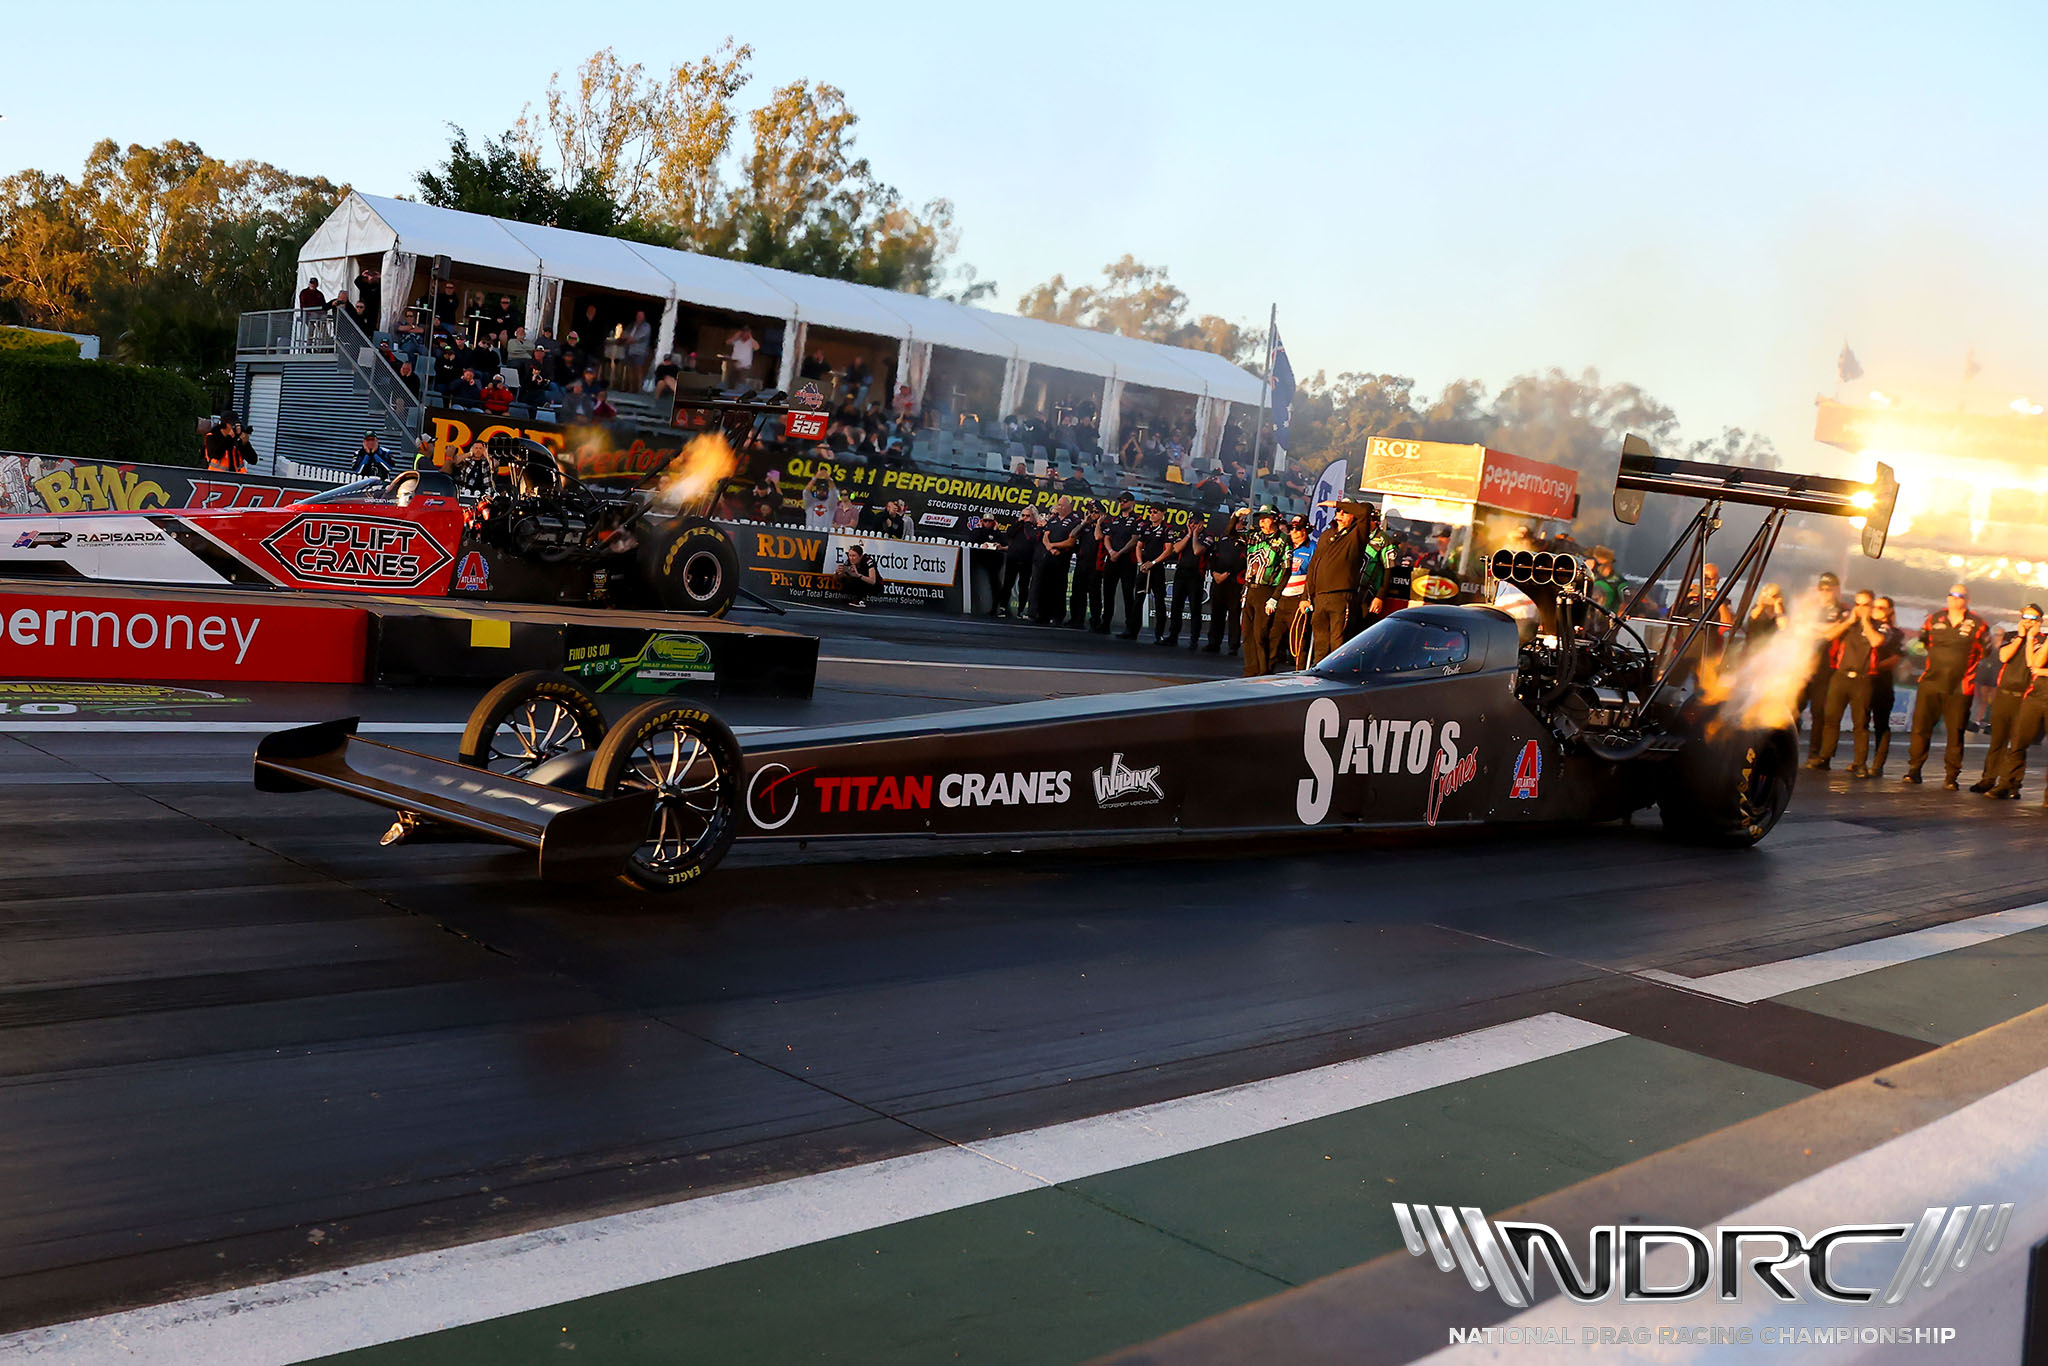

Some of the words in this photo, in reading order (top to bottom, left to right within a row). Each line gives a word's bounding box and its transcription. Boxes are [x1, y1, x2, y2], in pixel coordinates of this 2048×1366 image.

[791, 420, 821, 435] 526
[1372, 439, 1420, 460] RCE
[852, 466, 877, 485] #1
[883, 471, 1034, 505] PERFORMANCE
[1037, 491, 1093, 513] PATS
[1484, 464, 1573, 504] peppermoney
[927, 499, 967, 512] STOCKISTS
[968, 505, 978, 513] OF
[979, 506, 1010, 516] LEADING
[77, 532, 165, 542] RAPISARDA
[303, 521, 418, 553] UPLIFT
[756, 533, 822, 562] RDW
[295, 547, 420, 578] CRANES
[835, 547, 909, 570] Evator
[912, 553, 946, 573] Parts
[461, 576, 484, 584] ATLANTIC
[771, 571, 793, 587] Ph:
[798, 574, 813, 588] 07
[789, 588, 804, 597] Your
[806, 589, 823, 598] Total
[883, 584, 945, 599] rdw.com.au
[0, 608, 261, 665] ermoney
[568, 647, 586, 661] FIND
[587, 645, 598, 658] US
[600, 643, 610, 656] ON
[535, 682, 599, 718] GOODYEAR
[636, 709, 711, 739] GOODYEAR
[814, 775, 933, 813] TITAN
[939, 770, 1072, 808] CRANES
[1092, 752, 1165, 804] WILDINK
[1427, 746, 1479, 827] Cranes
[667, 865, 701, 884] EAGLE
